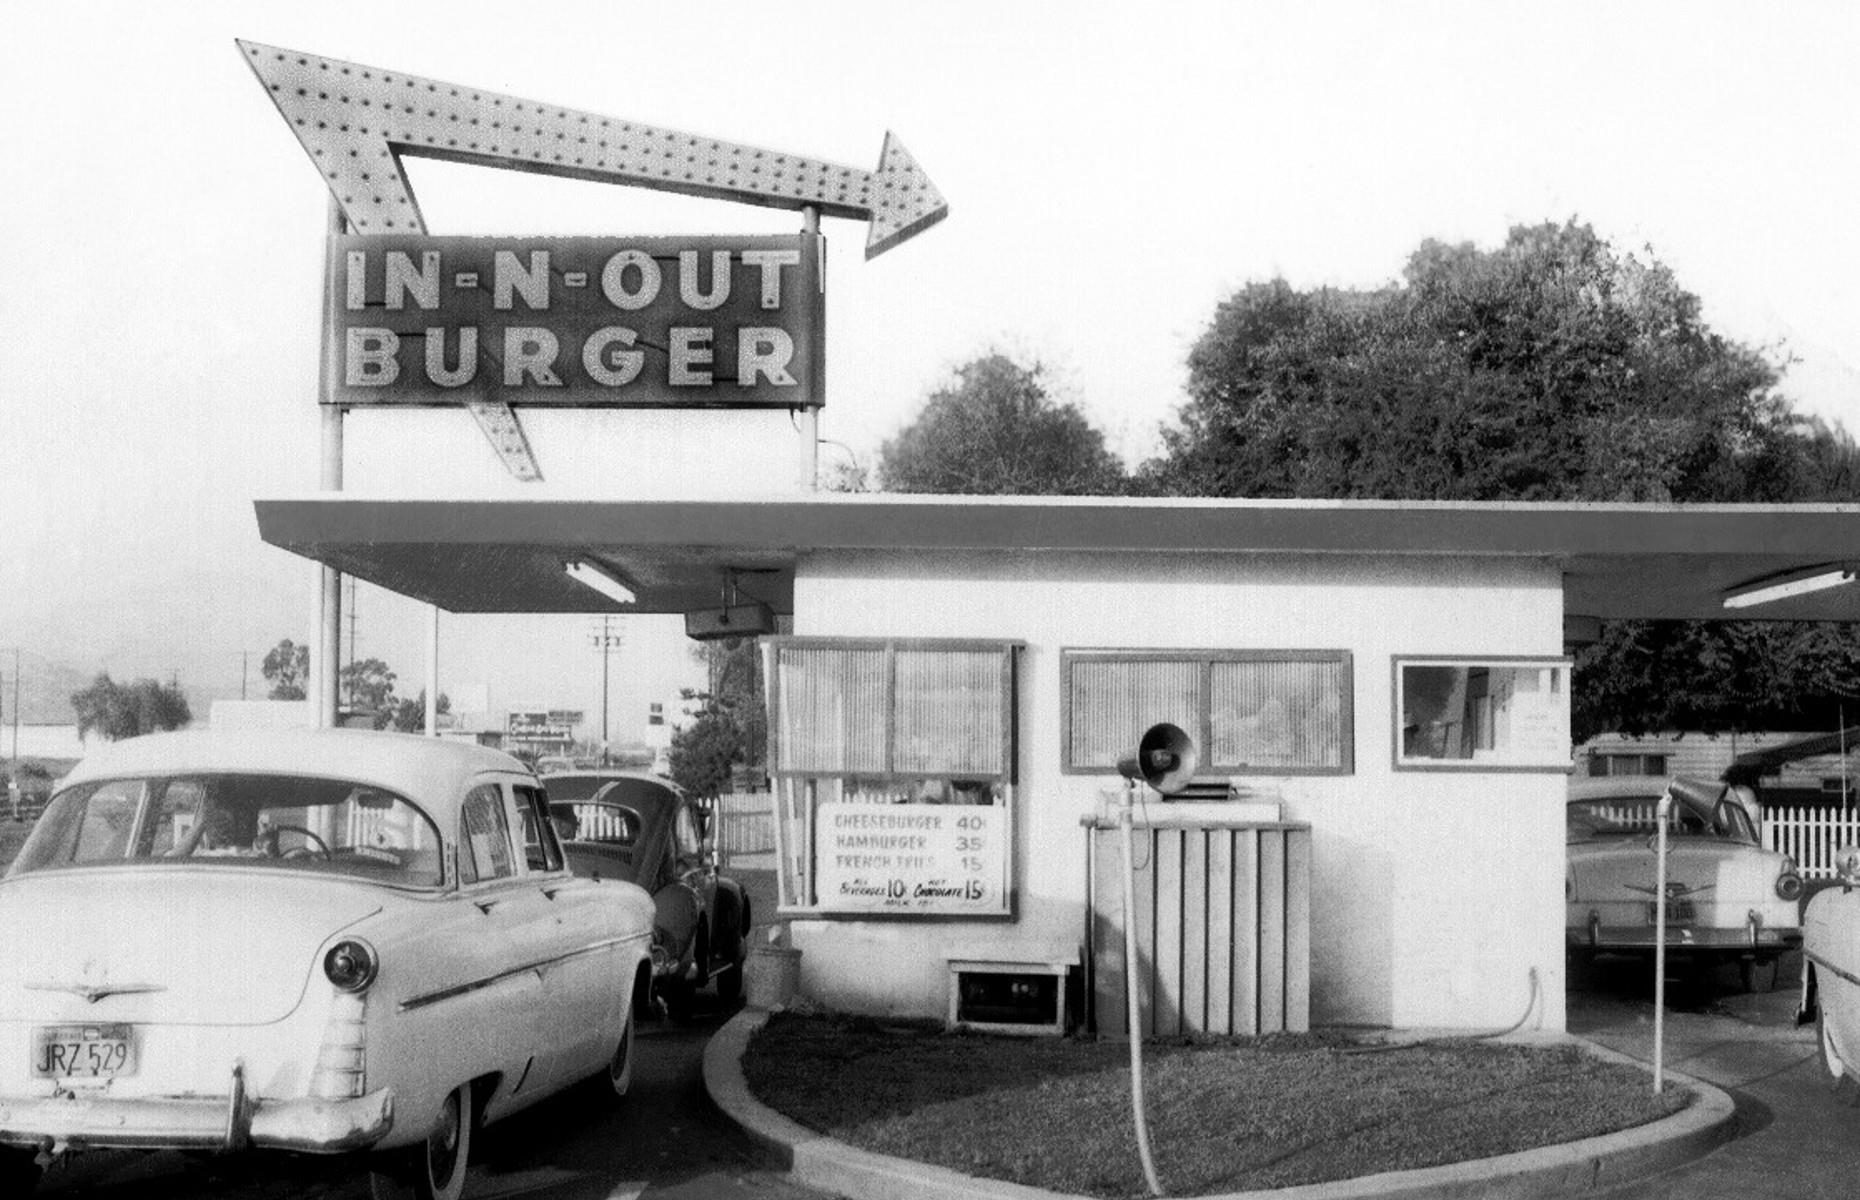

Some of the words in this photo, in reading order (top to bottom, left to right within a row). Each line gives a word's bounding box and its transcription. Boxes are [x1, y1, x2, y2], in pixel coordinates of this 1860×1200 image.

[346, 250, 800, 310] IN-N-OUT
[345, 327, 799, 387] BURGER
[834, 814, 943, 830] CHEESEBURGER
[836, 835, 927, 850] HAMBURGER
[836, 855, 892, 869] FRENCH
[37, 1043, 82, 1073] JRZ
[88, 1042, 127, 1073] 529
